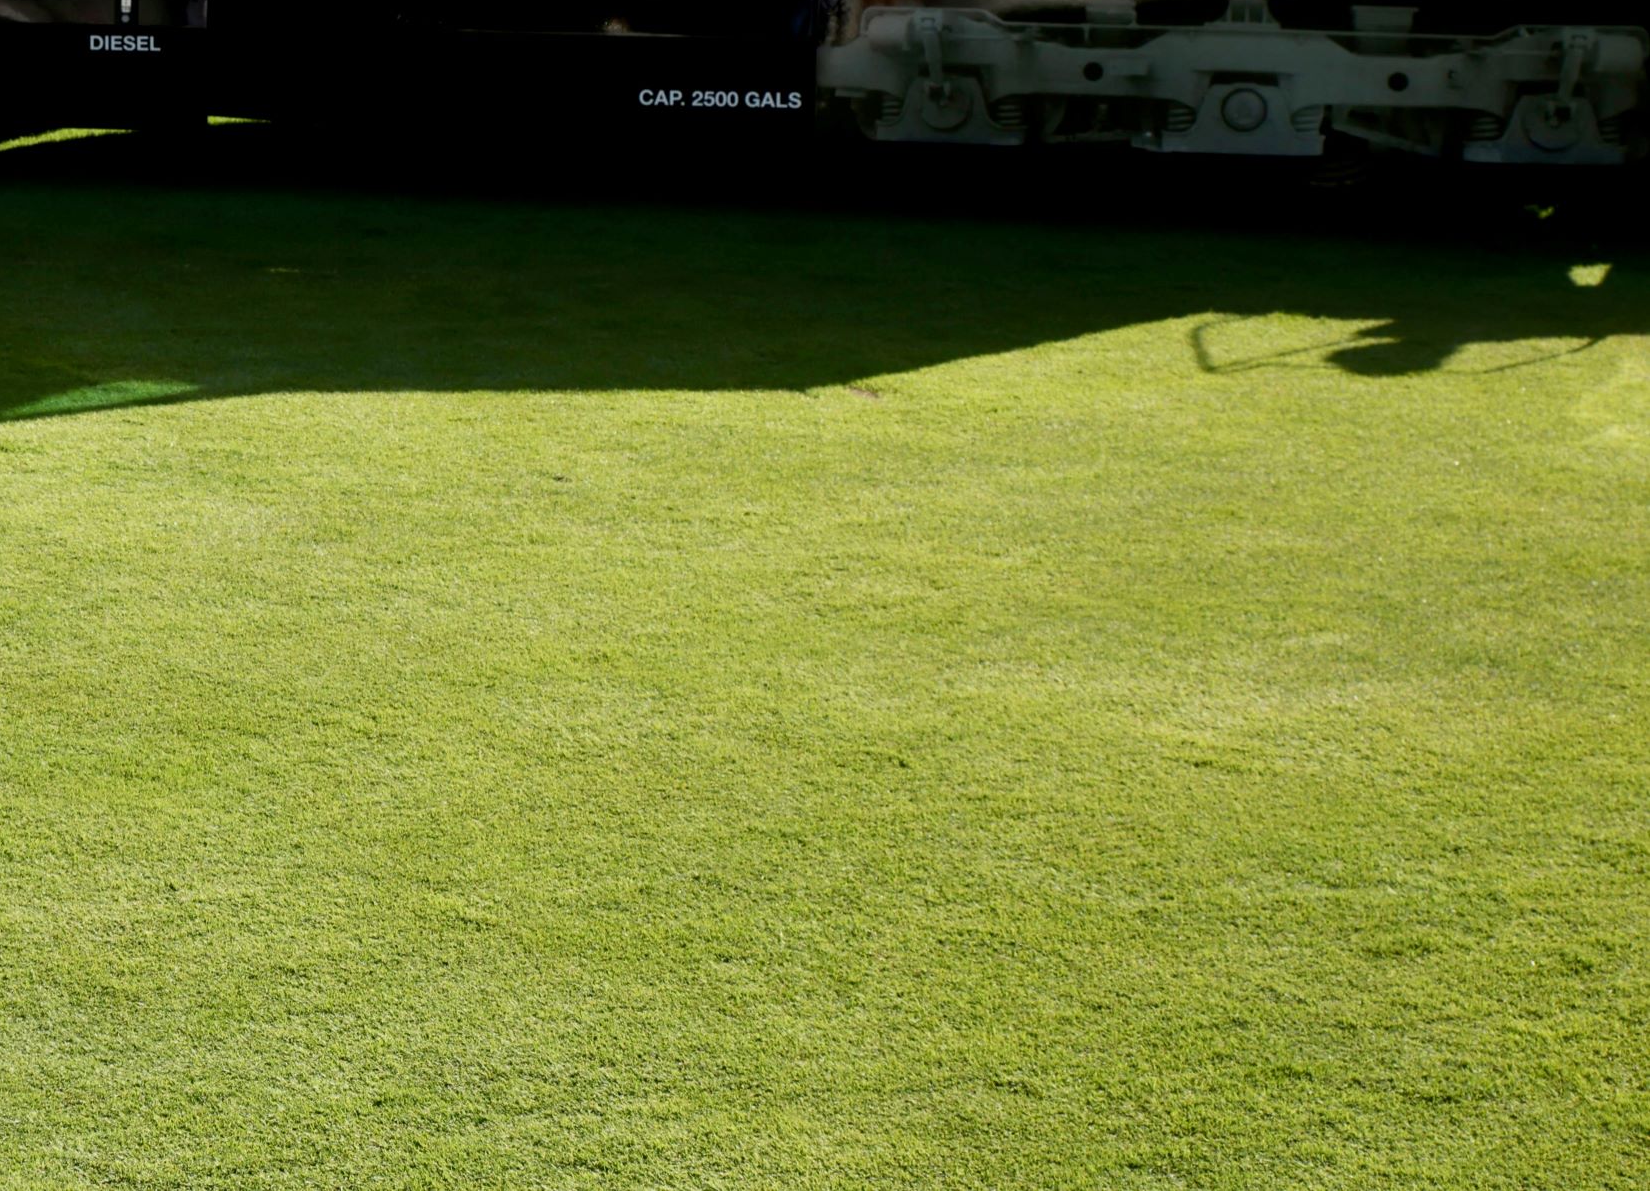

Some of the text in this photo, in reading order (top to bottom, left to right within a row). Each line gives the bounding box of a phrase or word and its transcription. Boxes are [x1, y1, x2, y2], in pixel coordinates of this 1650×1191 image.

[89, 35, 161, 52] DIESEL
[639, 89, 802, 109] CAP. 2500 GALS
